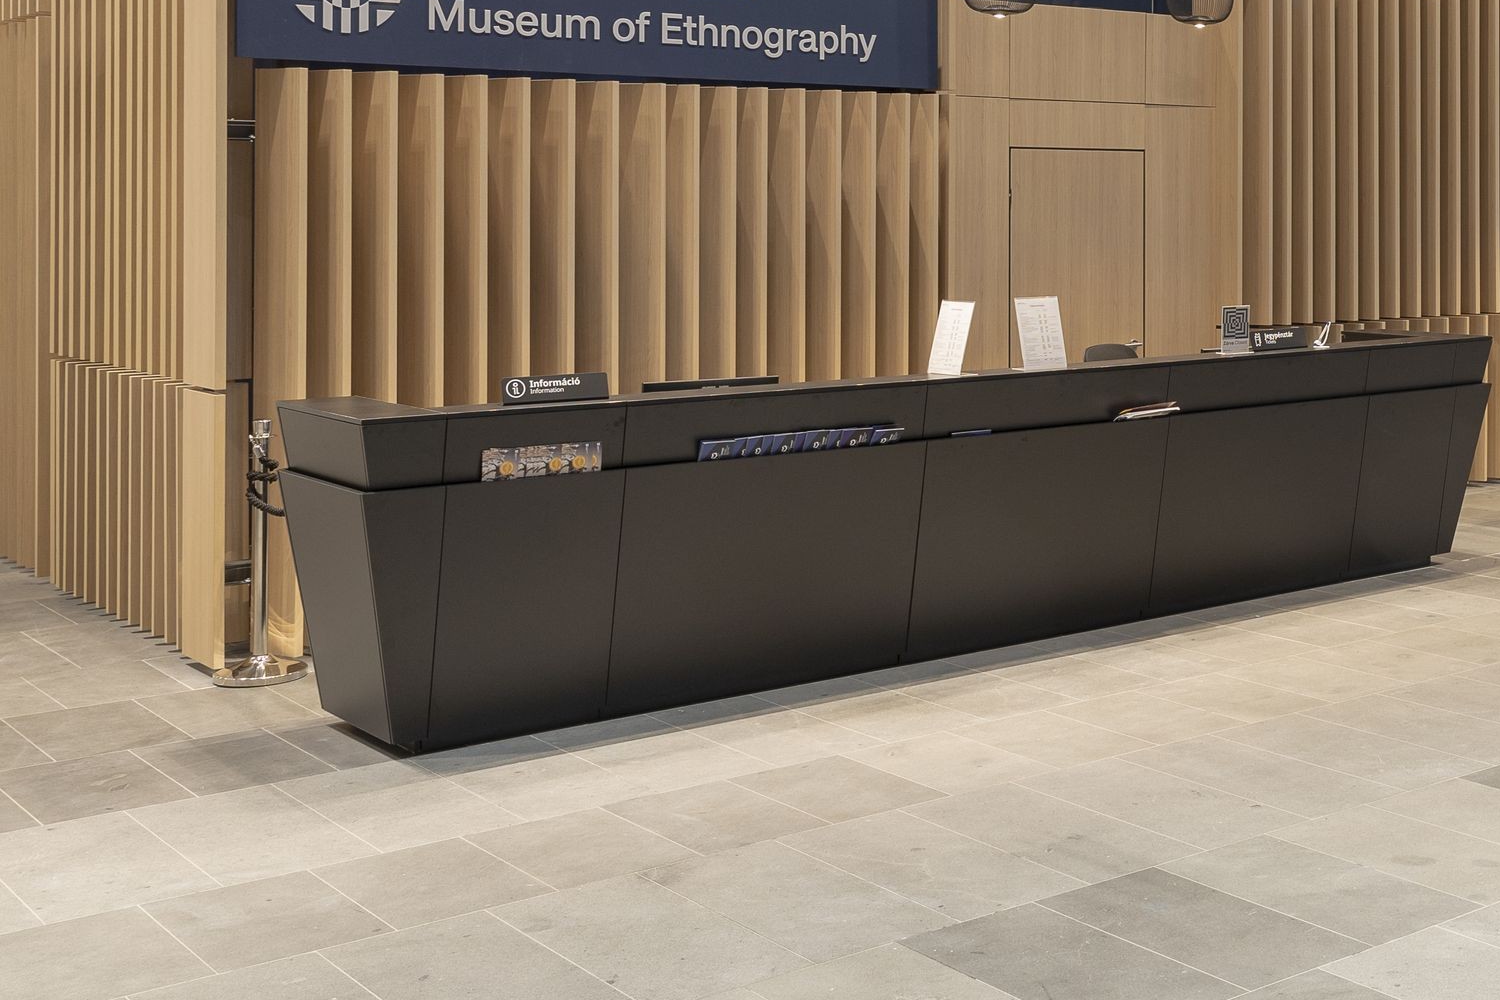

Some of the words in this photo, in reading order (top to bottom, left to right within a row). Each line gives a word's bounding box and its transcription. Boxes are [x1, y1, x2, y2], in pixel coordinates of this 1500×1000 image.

[612, 12, 650, 42] of
[661, 12, 877, 62] Ethnography
[529, 377, 581, 388] Információ
